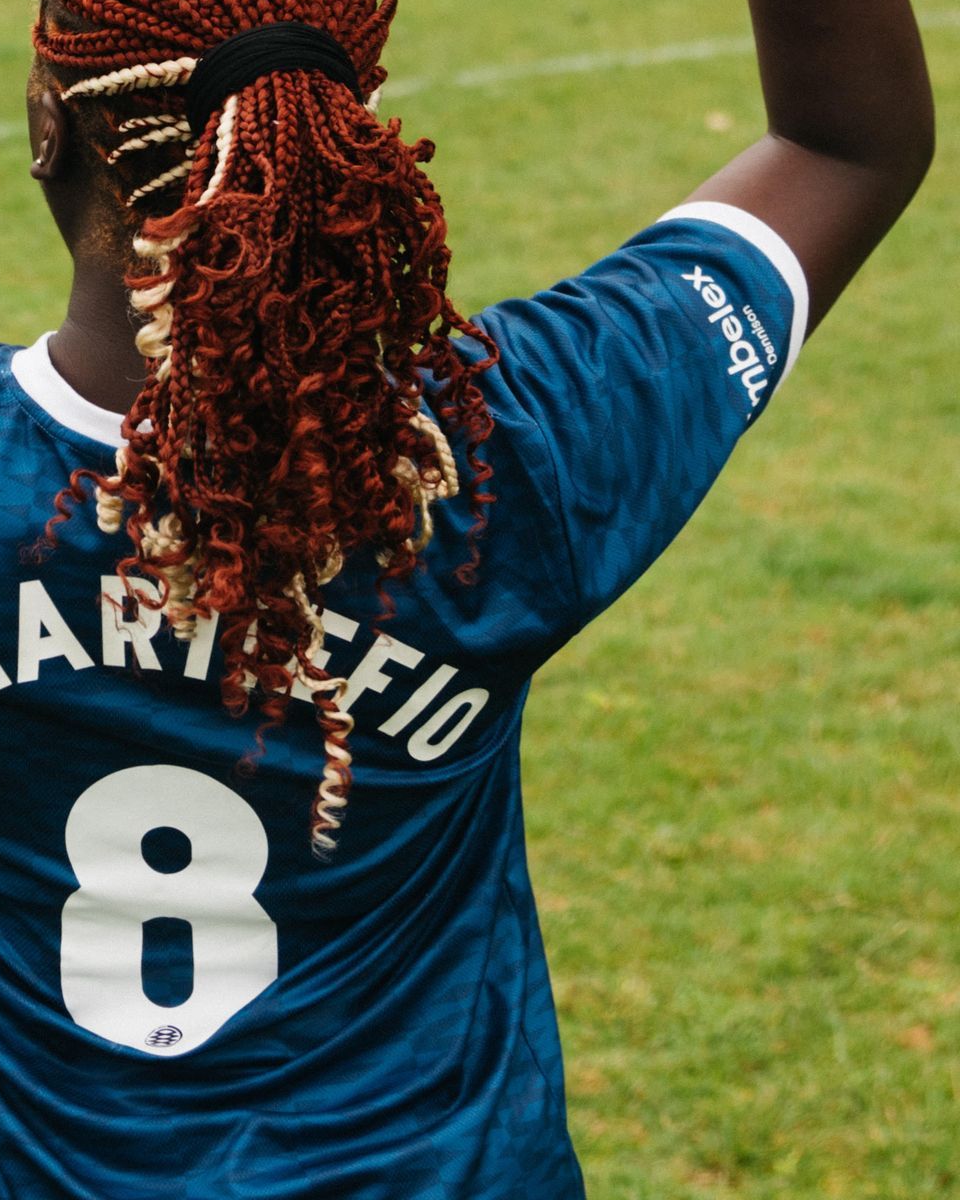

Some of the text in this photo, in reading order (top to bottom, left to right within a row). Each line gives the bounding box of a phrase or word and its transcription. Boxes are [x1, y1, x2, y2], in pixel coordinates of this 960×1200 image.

[681, 265, 769, 421] mbelex
[743, 304, 778, 366] Dennison
[60, 764, 279, 1057] 8
